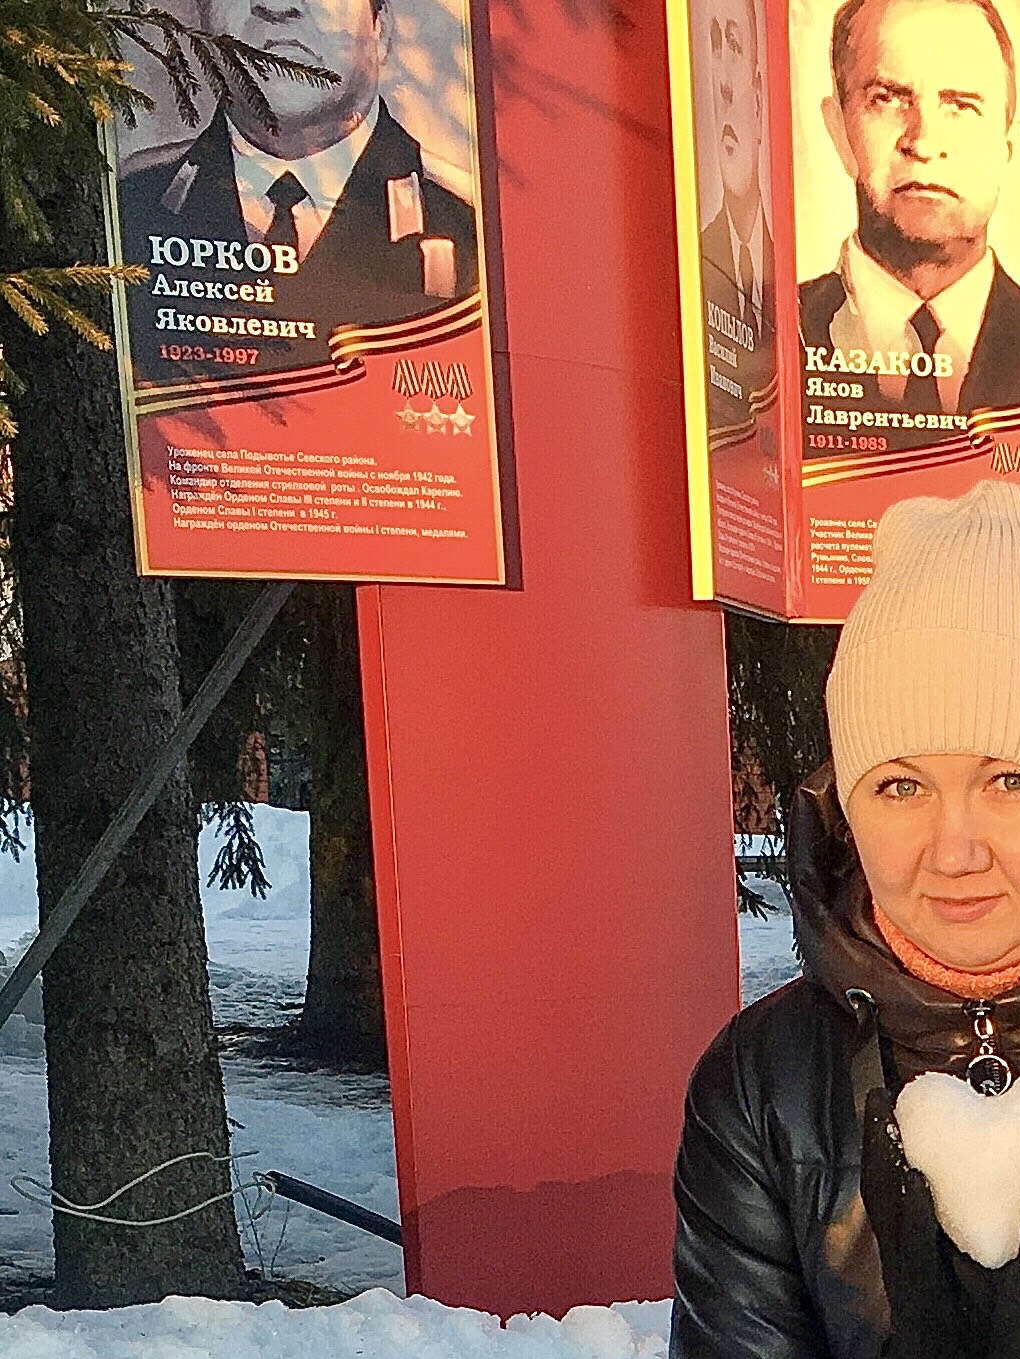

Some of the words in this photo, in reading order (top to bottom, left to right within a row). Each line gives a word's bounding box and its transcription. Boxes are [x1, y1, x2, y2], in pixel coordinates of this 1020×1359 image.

[149, 235, 299, 274] ЮРКОВ
[152, 273, 275, 303] Алексей
[155, 308, 316, 338] Яковлевич
[707, 300, 754, 352] КОПЫЛОВ
[160, 344, 259, 365] 1923-1997
[805, 347, 953, 377] КАЗАКОВ
[806, 377, 864, 398] Яков
[807, 405, 968, 430] Лаврентьевич
[808, 434, 888, 450] 1911-1983
[167, 445, 214, 459] Уроженец
[216, 450, 238, 459] села
[297, 452, 340, 464] Севского
[169, 461, 181, 471] На
[183, 461, 219, 473] фронте
[221, 463, 261, 474] Великой
[264, 464, 335, 477] Отечественной
[337, 469, 368, 479] войны
[378, 470, 410, 482] ноября
[413, 472, 432, 482] 1942
[170, 475, 217, 488] Командир
[220, 479, 269, 489] отделения
[272, 480, 326, 491] стрелковой
[362, 483, 419, 496] Освобождал
[173, 503, 215, 515] Орденом
[218, 505, 250, 516] Славы
[258, 508, 295, 518] степени
[309, 508, 329, 519] 1945
[224, 491, 267, 503] Орденом
[269, 493, 302, 504] Славы
[314, 496, 351, 506] степени
[369, 499, 405, 508] степени
[416, 499, 435, 510] 1944
[227, 521, 268, 531] орденом
[270, 520, 340, 534] Отечественной
[343, 524, 374, 534] войны
[846, 530, 873, 540] Велико
[842, 543, 872, 553] пулемет
